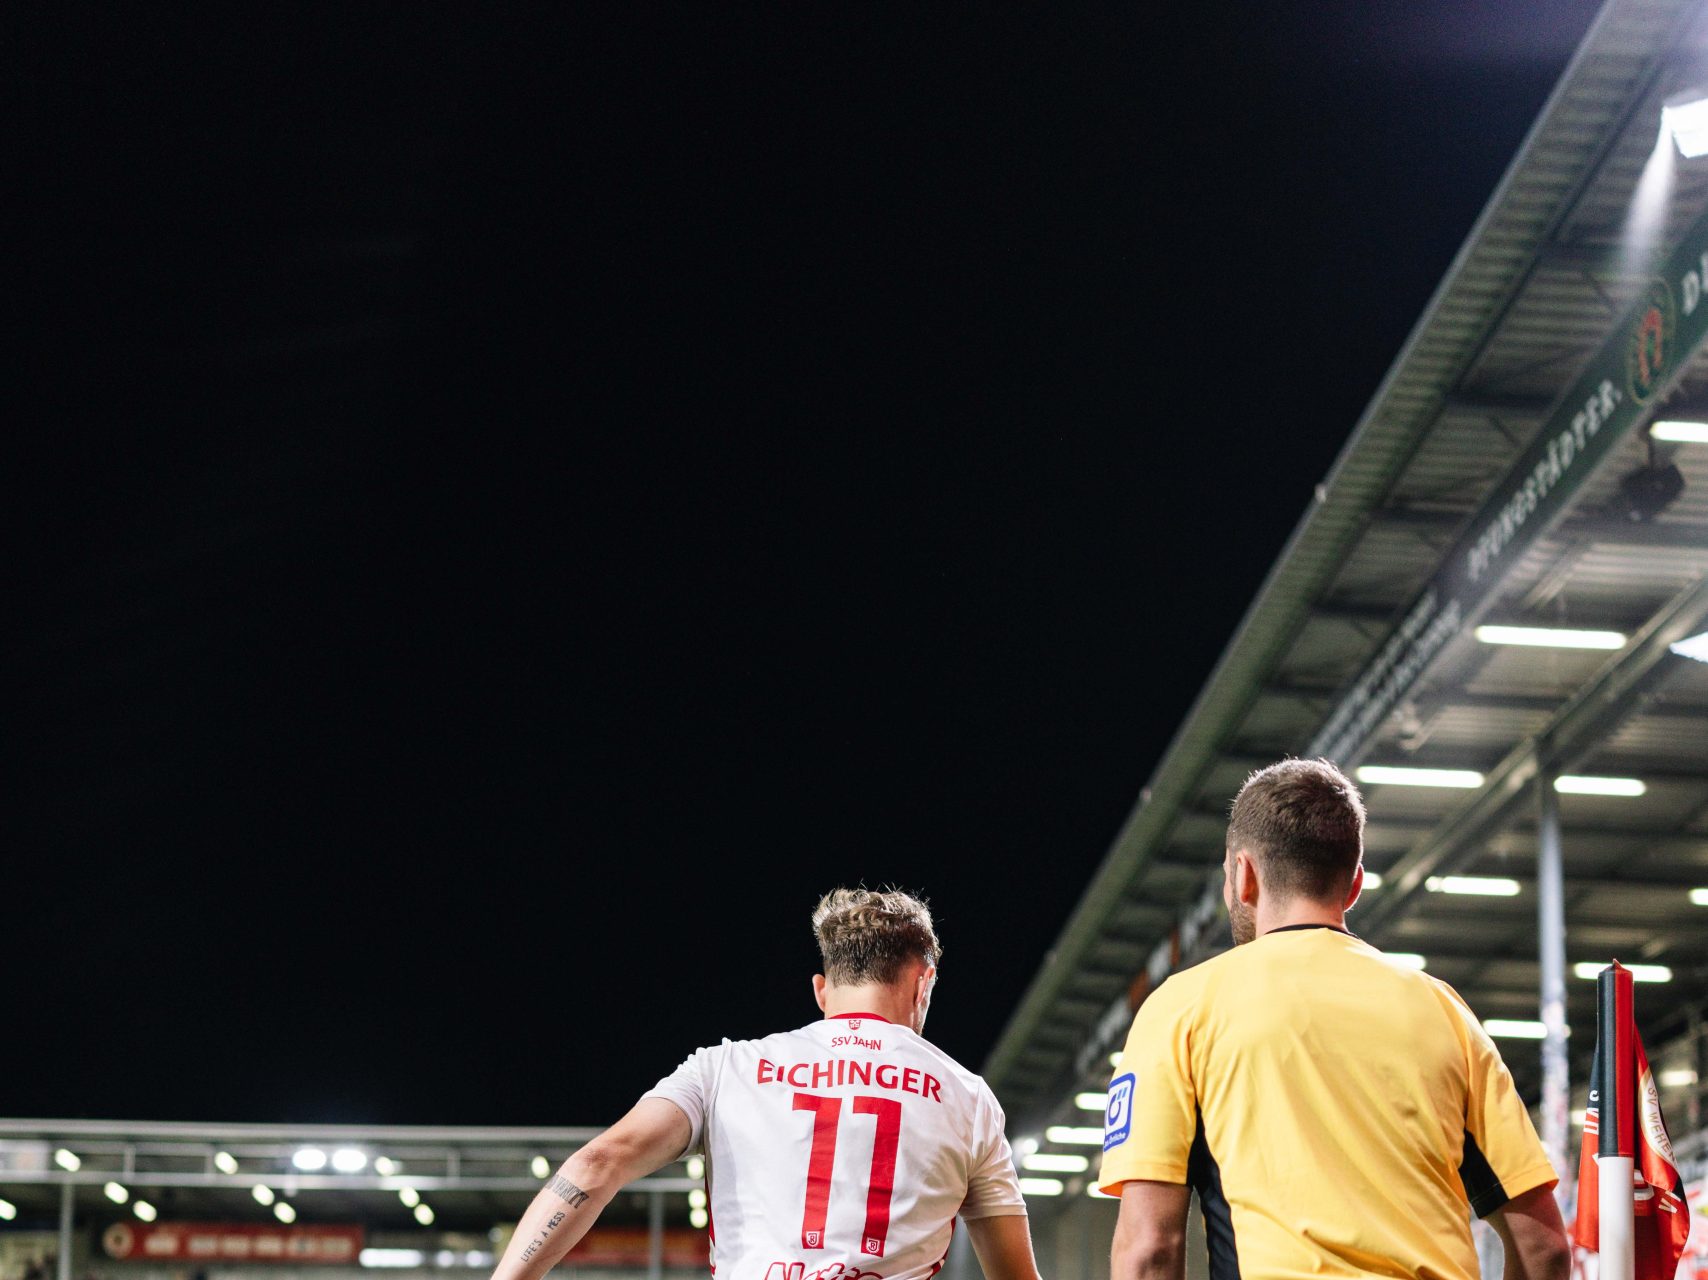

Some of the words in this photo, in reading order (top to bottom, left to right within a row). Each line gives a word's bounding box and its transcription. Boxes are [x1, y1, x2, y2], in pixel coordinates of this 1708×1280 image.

[831, 1035, 851, 1047] SSV
[852, 1036, 882, 1050] JAHN
[758, 1058, 941, 1103] EICHINGER
[792, 1092, 902, 1258] 11
[521, 1239, 543, 1262] LIFE'S
[541, 1230, 549, 1239] A
[547, 1212, 565, 1230] MESS
